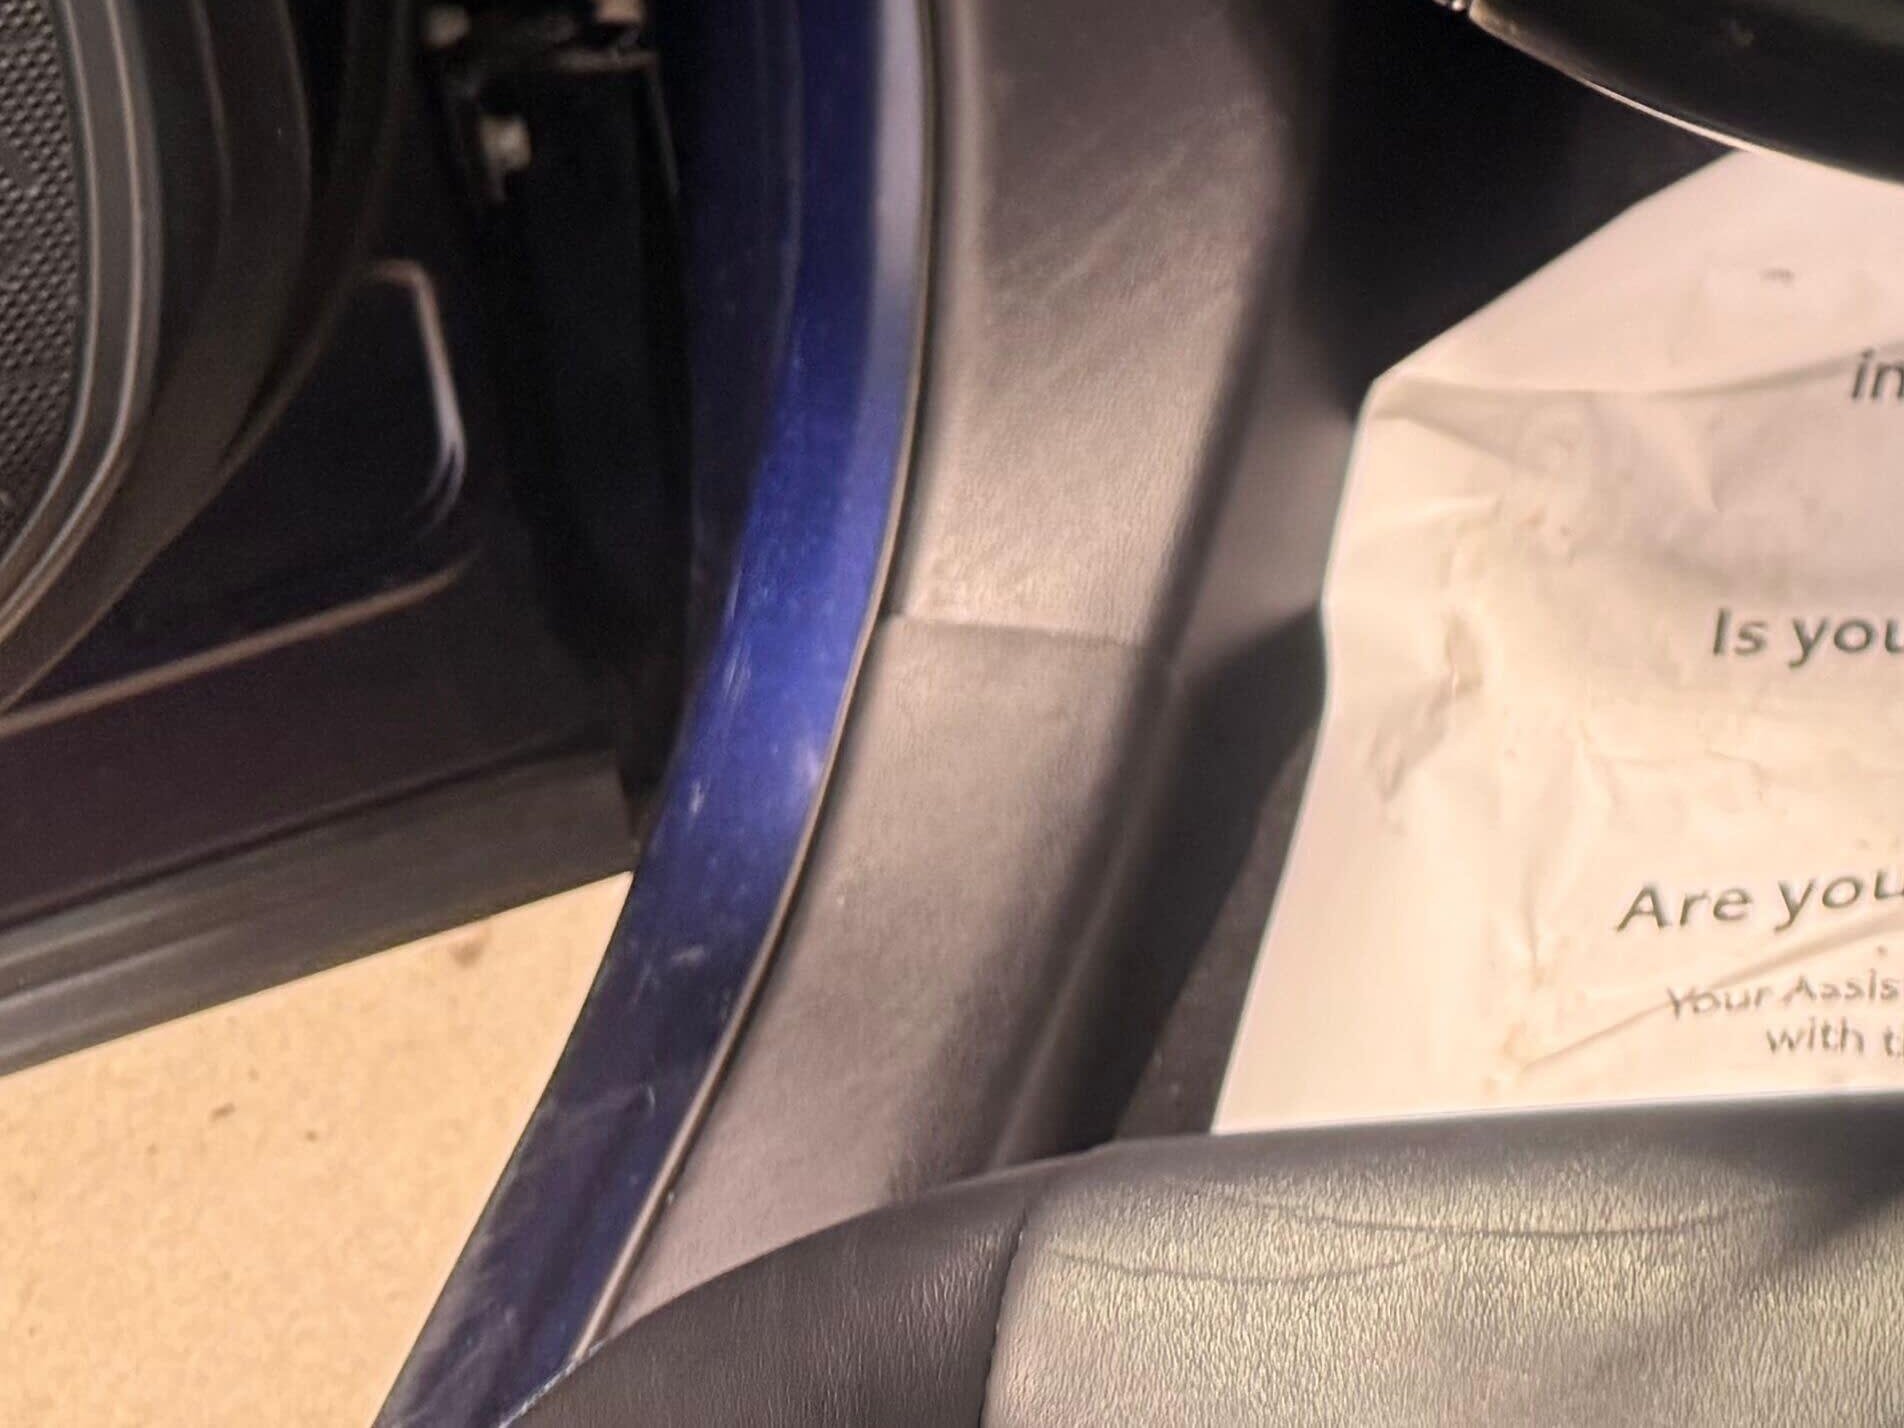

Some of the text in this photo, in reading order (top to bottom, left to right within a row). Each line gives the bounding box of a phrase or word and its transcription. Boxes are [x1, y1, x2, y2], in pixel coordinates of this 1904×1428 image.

[1711, 607, 1768, 656] Is
[1614, 876, 1755, 934] Are
[1665, 979, 1769, 1020] Your
[1764, 1018, 1866, 1057] with
